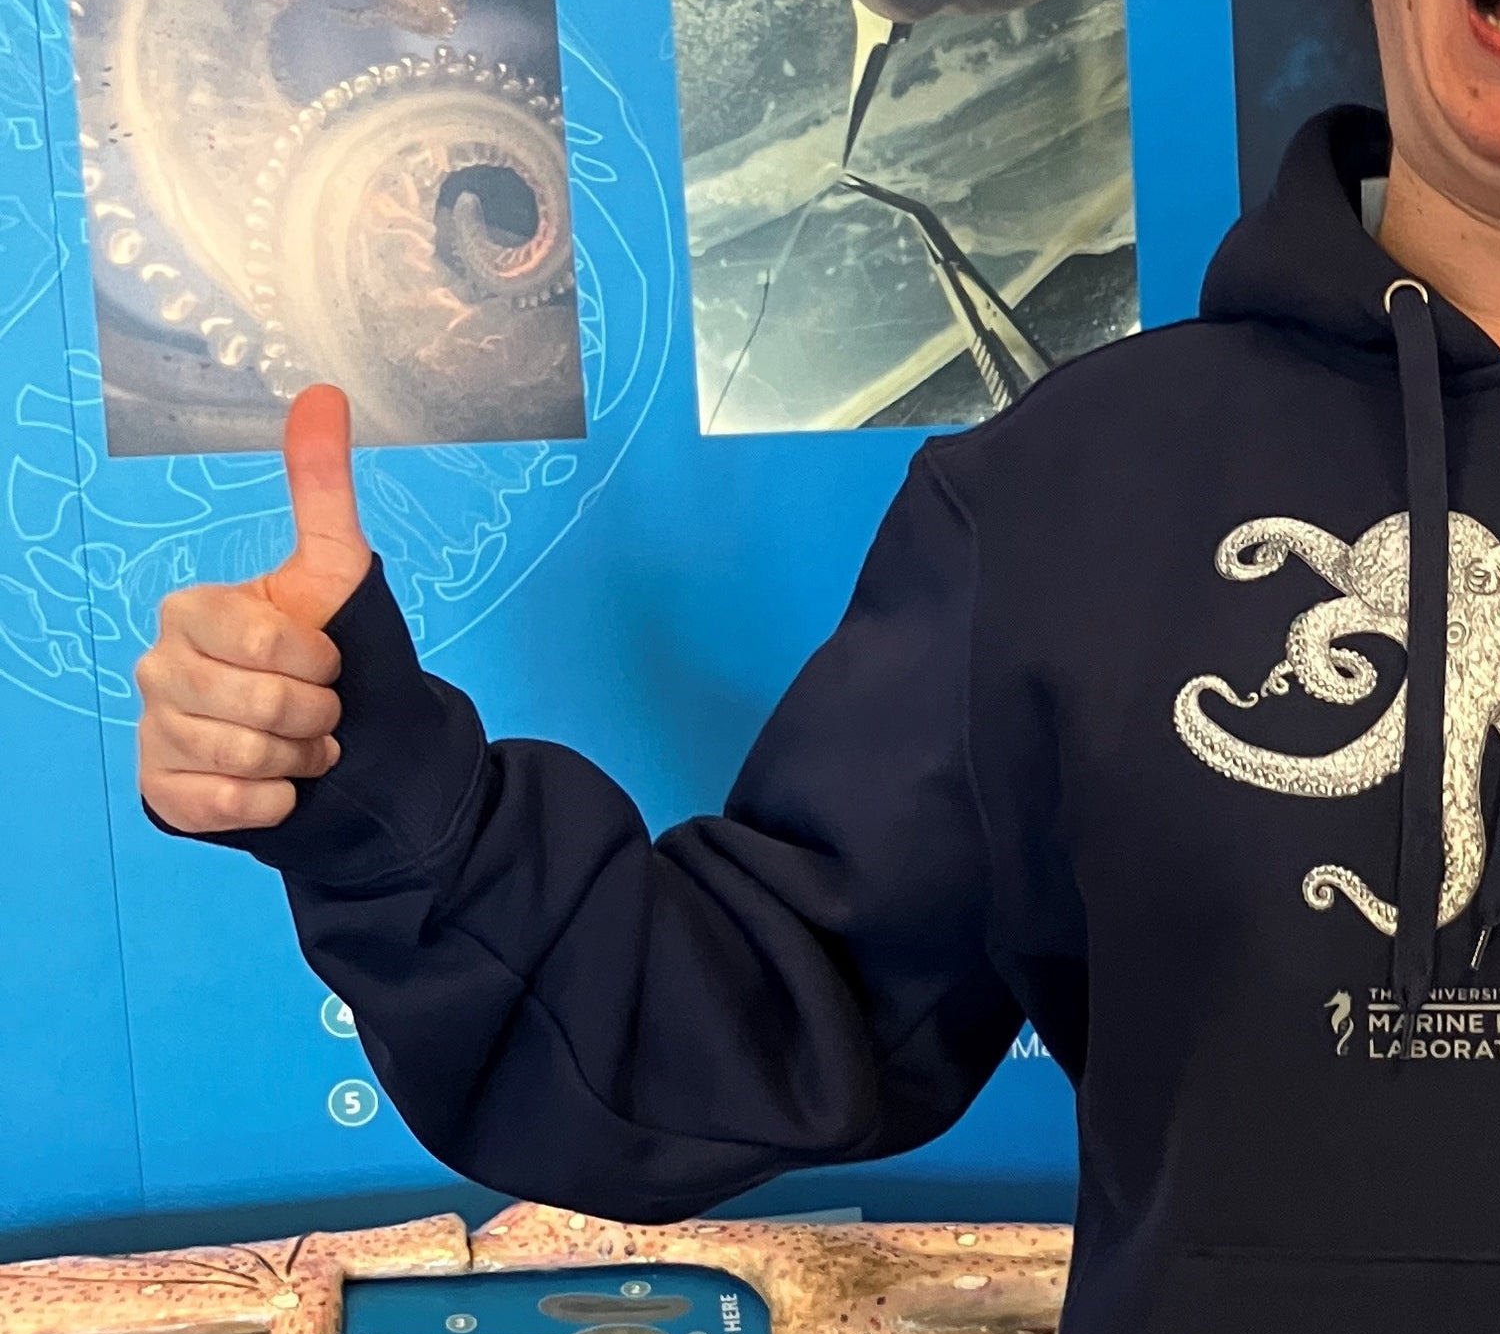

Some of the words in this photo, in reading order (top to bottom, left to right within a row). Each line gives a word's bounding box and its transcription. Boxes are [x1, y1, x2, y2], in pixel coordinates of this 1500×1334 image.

[1368, 987, 1392, 1001] TH
[344, 1091, 361, 1115] 5
[720, 1293, 741, 1332] HERE
